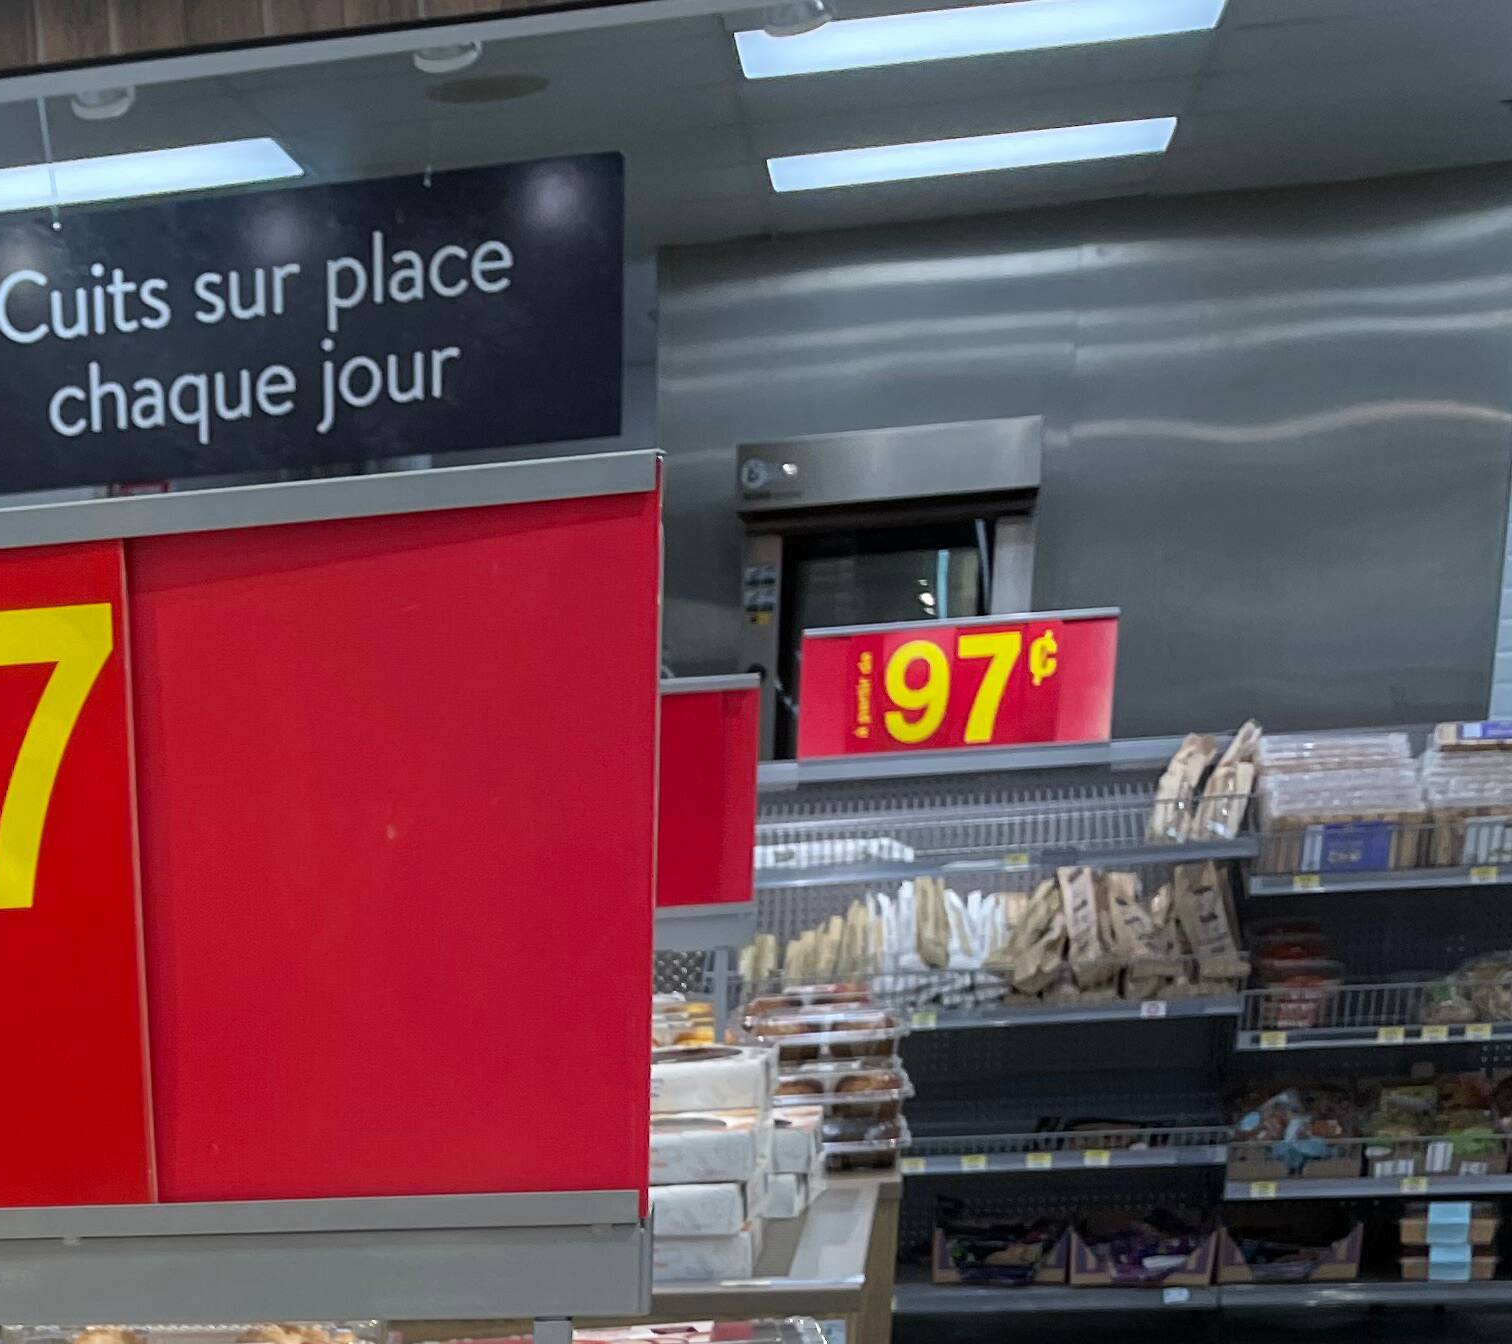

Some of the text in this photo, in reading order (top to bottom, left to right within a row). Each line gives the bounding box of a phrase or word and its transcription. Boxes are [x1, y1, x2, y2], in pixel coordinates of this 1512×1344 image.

[195, 261, 299, 325] sur
[326, 230, 514, 331] place
[48, 338, 460, 444] chaque jour
